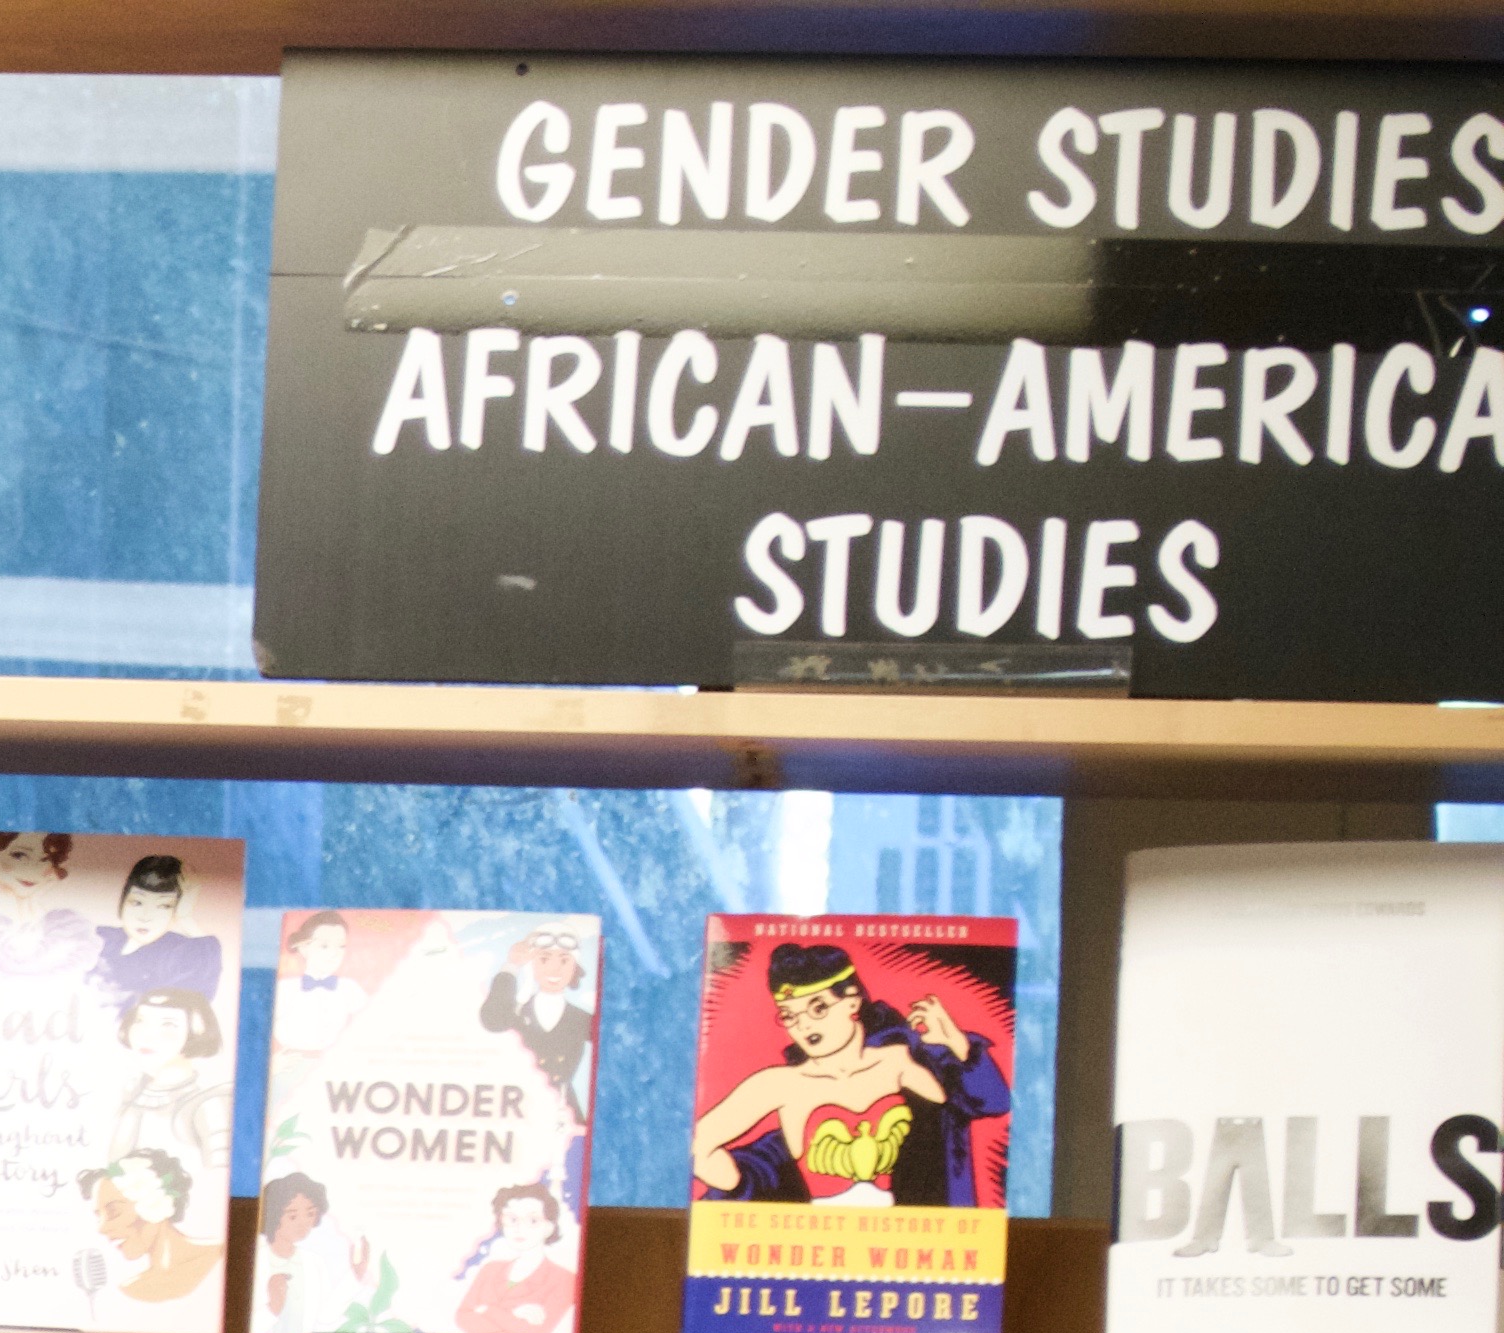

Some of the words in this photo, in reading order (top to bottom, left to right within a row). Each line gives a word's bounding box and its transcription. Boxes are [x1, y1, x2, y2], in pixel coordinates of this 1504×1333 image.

[495, 100, 977, 228] GENDER
[1027, 106, 1504, 234] STUDIES
[734, 512, 1220, 644] STUDIES
[326, 1079, 526, 1119] WONDER
[330, 1124, 515, 1165] WOMEN
[1115, 1113, 1504, 1255] BALLS
[720, 1211, 756, 1232] THE
[764, 1213, 848, 1233] SECRET
[856, 1215, 945, 1237] HISTORY
[954, 1217, 982, 1238] OF
[718, 1241, 845, 1269] WONDER
[867, 1245, 979, 1271] WOMAN
[713, 1285, 806, 1318] JILL
[829, 1289, 981, 1321] LEPORE
[1250, 1276, 1308, 1298] SOME
[1315, 1276, 1340, 1298] TO
[1345, 1276, 1383, 1298] GET
[1389, 1276, 1448, 1298] SOME
